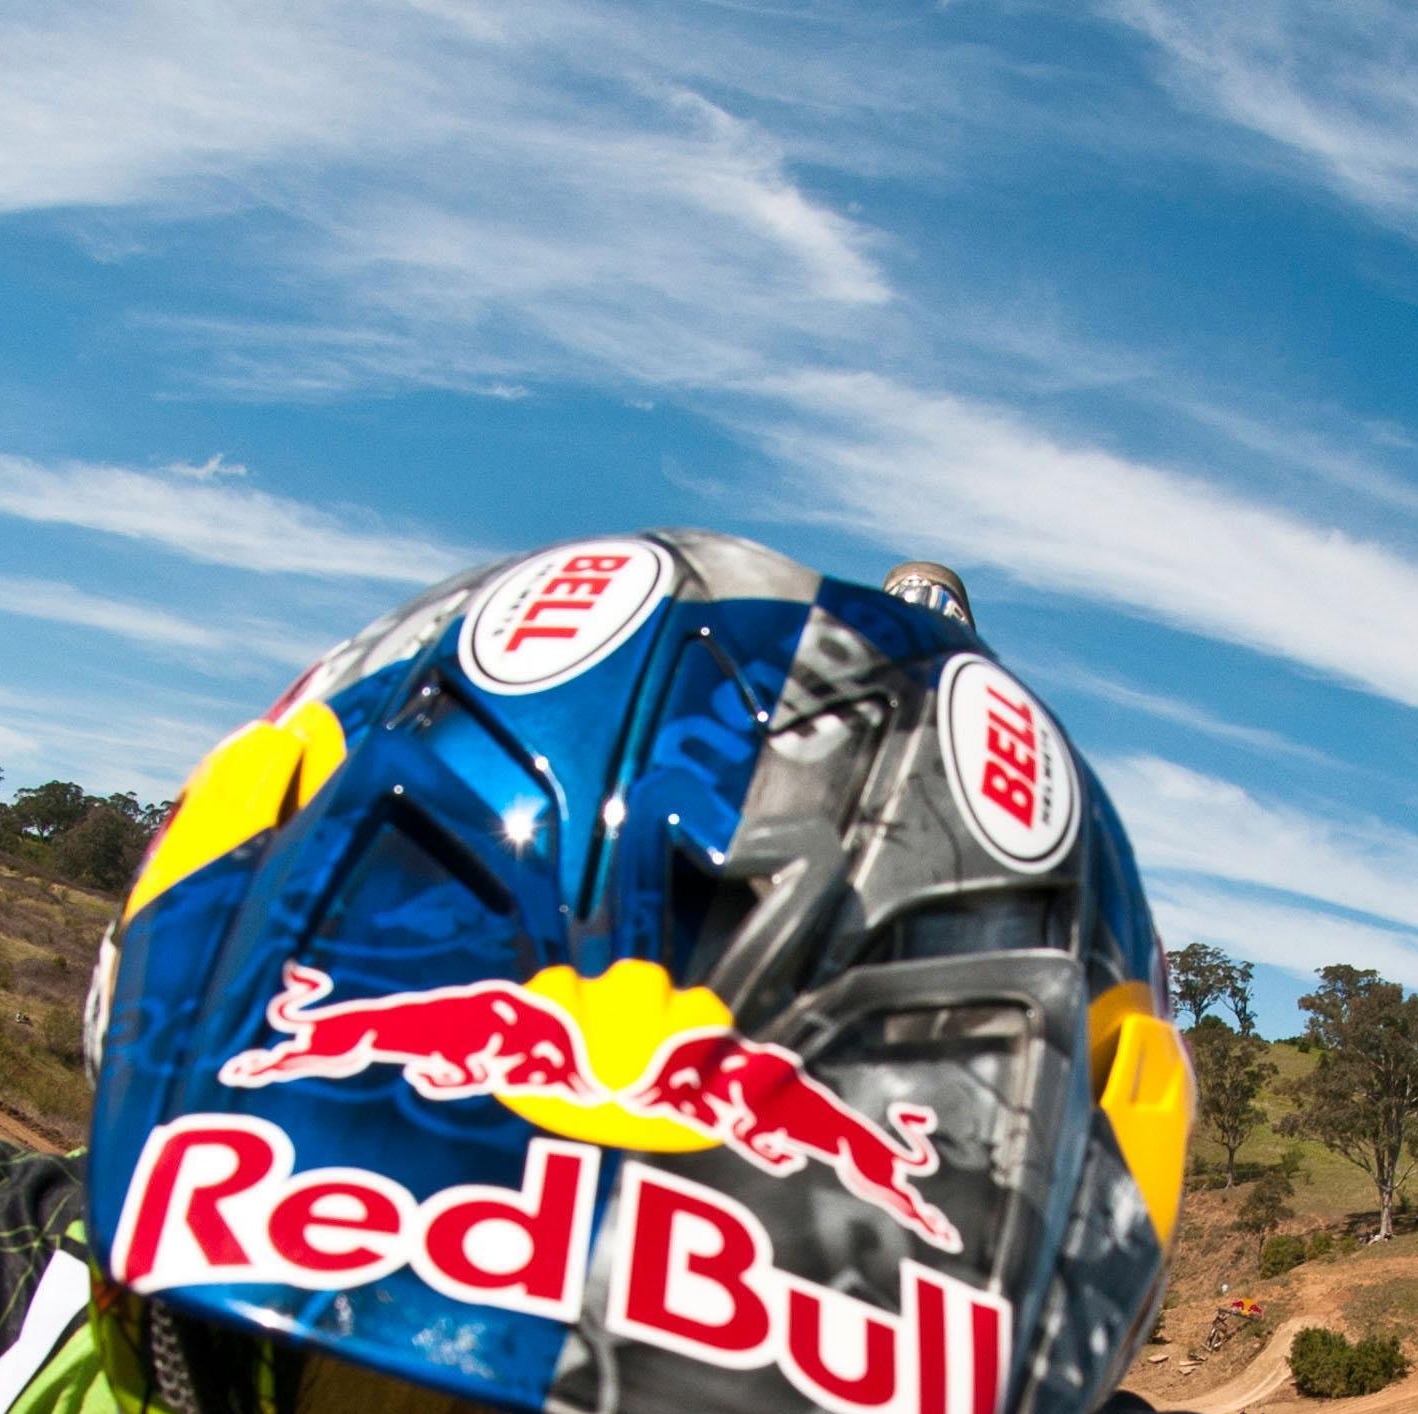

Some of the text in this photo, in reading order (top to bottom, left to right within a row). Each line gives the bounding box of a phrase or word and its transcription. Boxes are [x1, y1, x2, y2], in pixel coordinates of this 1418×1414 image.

[504, 556, 632, 653] BELL
[981, 685, 1037, 830] BELL
[113, 1116, 599, 1324] Red
